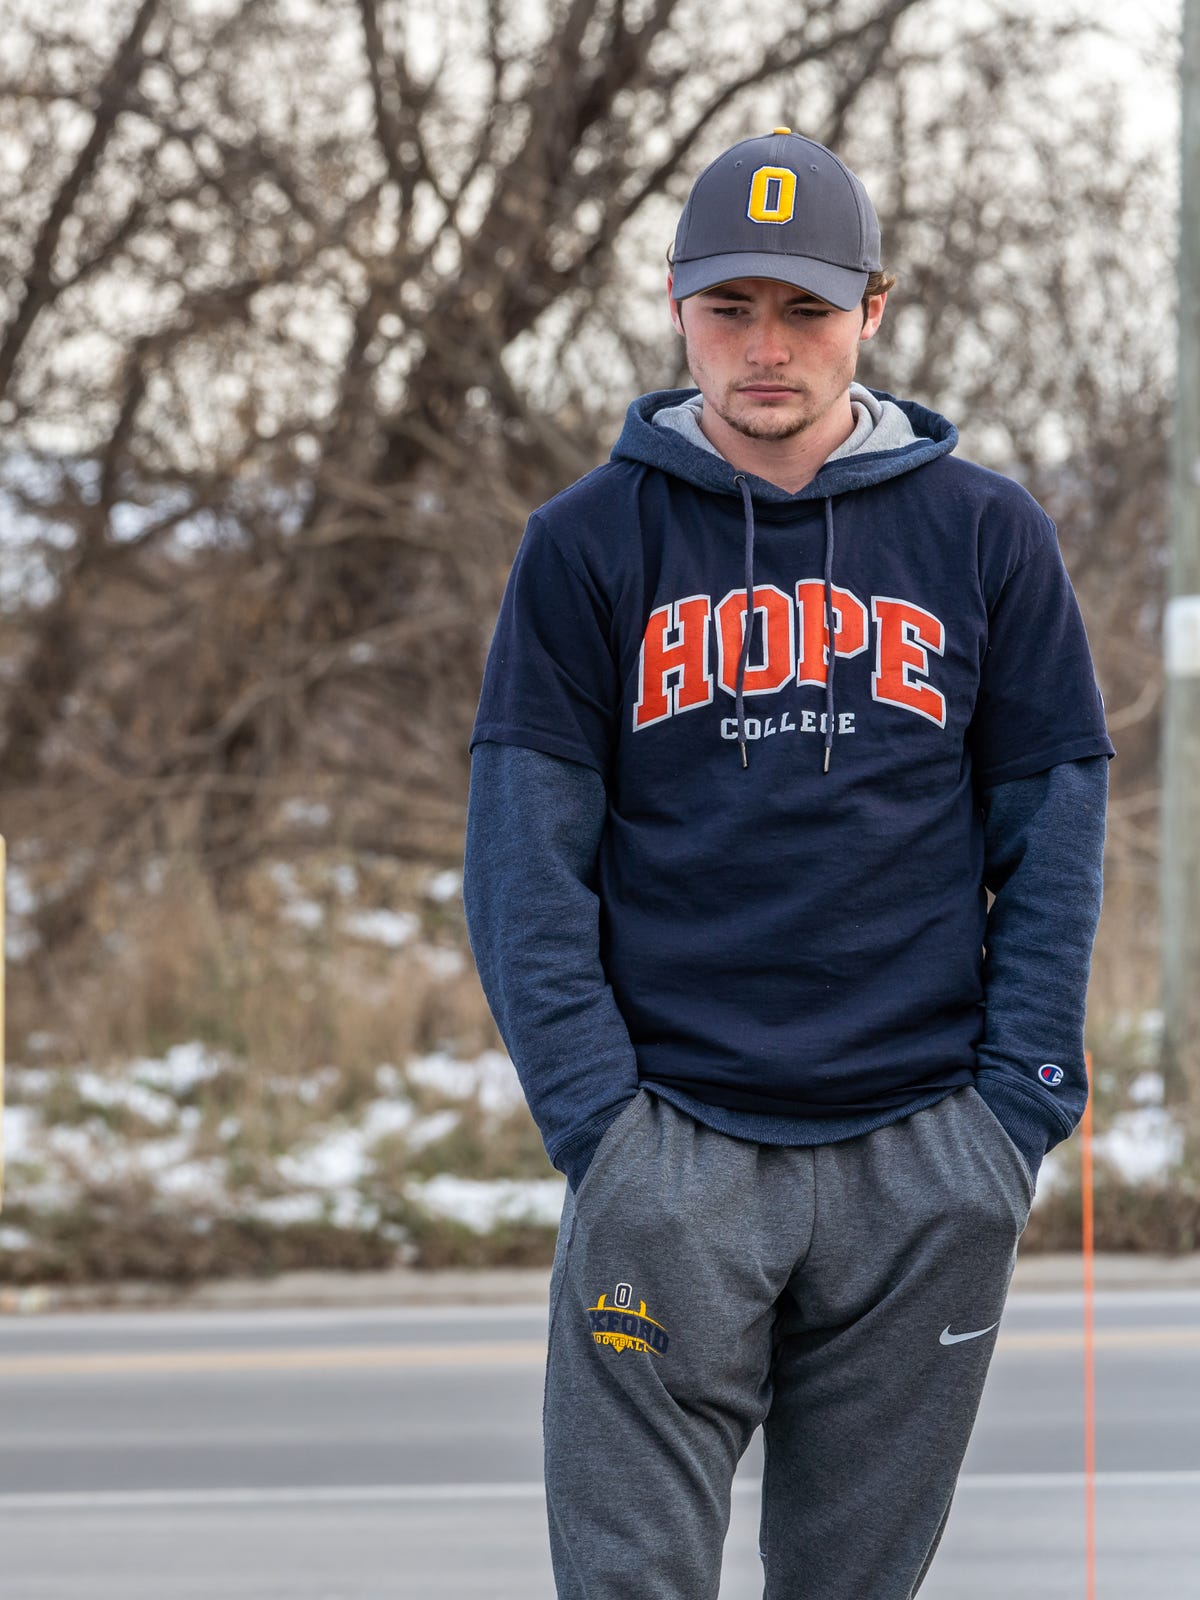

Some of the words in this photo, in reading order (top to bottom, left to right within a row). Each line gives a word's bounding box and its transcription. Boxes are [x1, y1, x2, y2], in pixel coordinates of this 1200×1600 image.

[746, 164, 798, 225] O
[632, 578, 946, 733] HOPE
[720, 710, 856, 740] COLLEGE
[588, 1311, 670, 1354] XFORD
